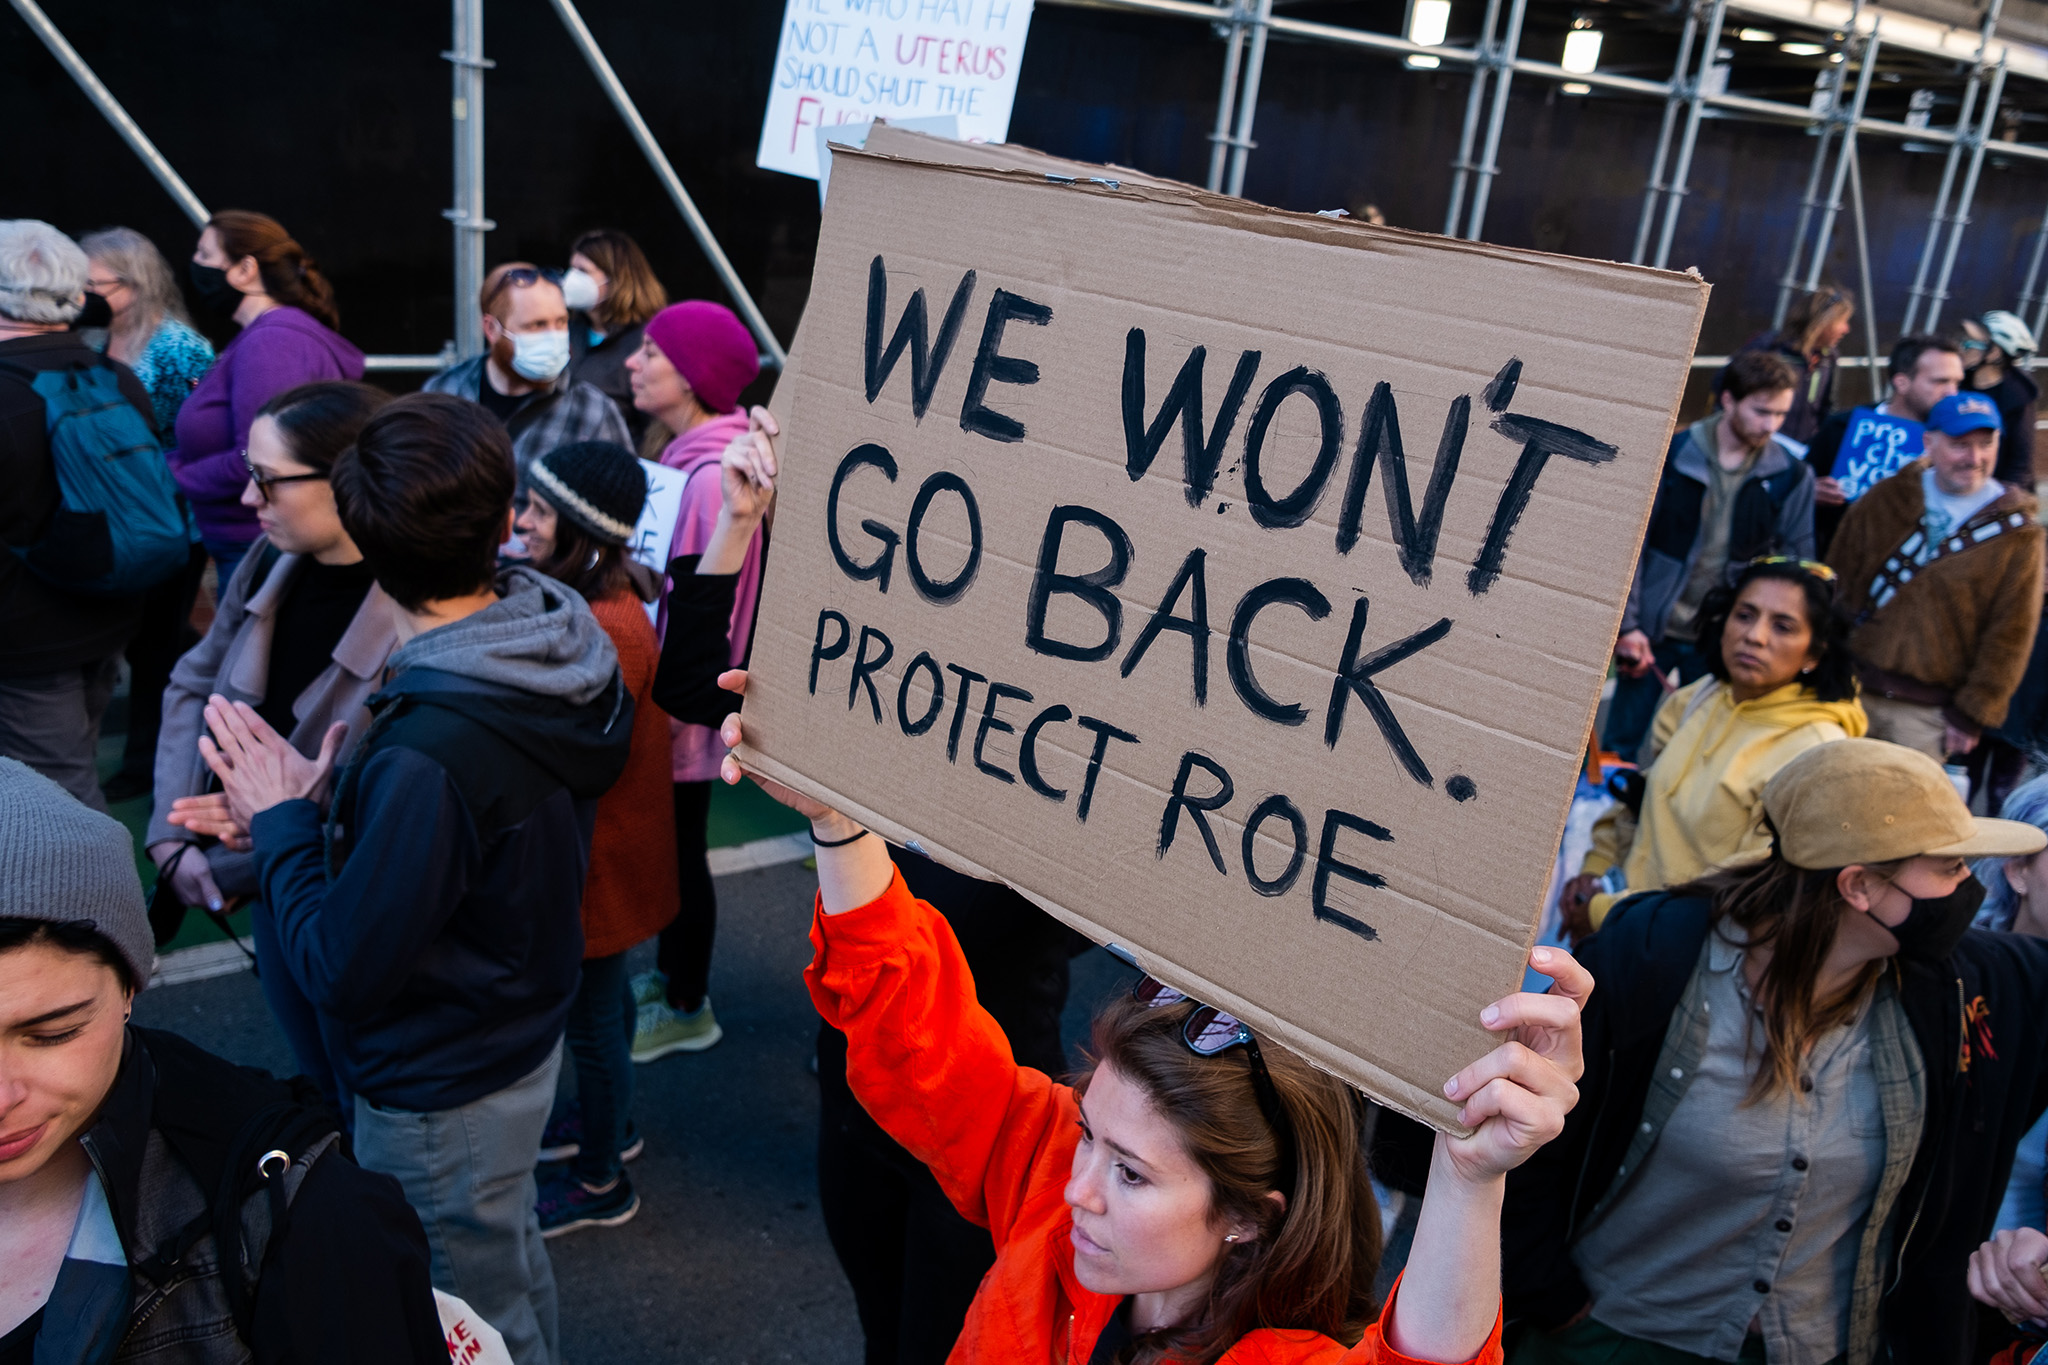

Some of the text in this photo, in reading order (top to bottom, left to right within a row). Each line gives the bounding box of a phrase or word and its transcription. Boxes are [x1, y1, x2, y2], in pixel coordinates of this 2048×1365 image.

[780, 56, 984, 116] SHOULD SHUT THE
[786, 20, 1007, 80] NOT A UTERUS
[865, 254, 1617, 596] WE WON'T
[809, 608, 1394, 941] PROTECT ROE
[827, 441, 1479, 802] GO BACK.
